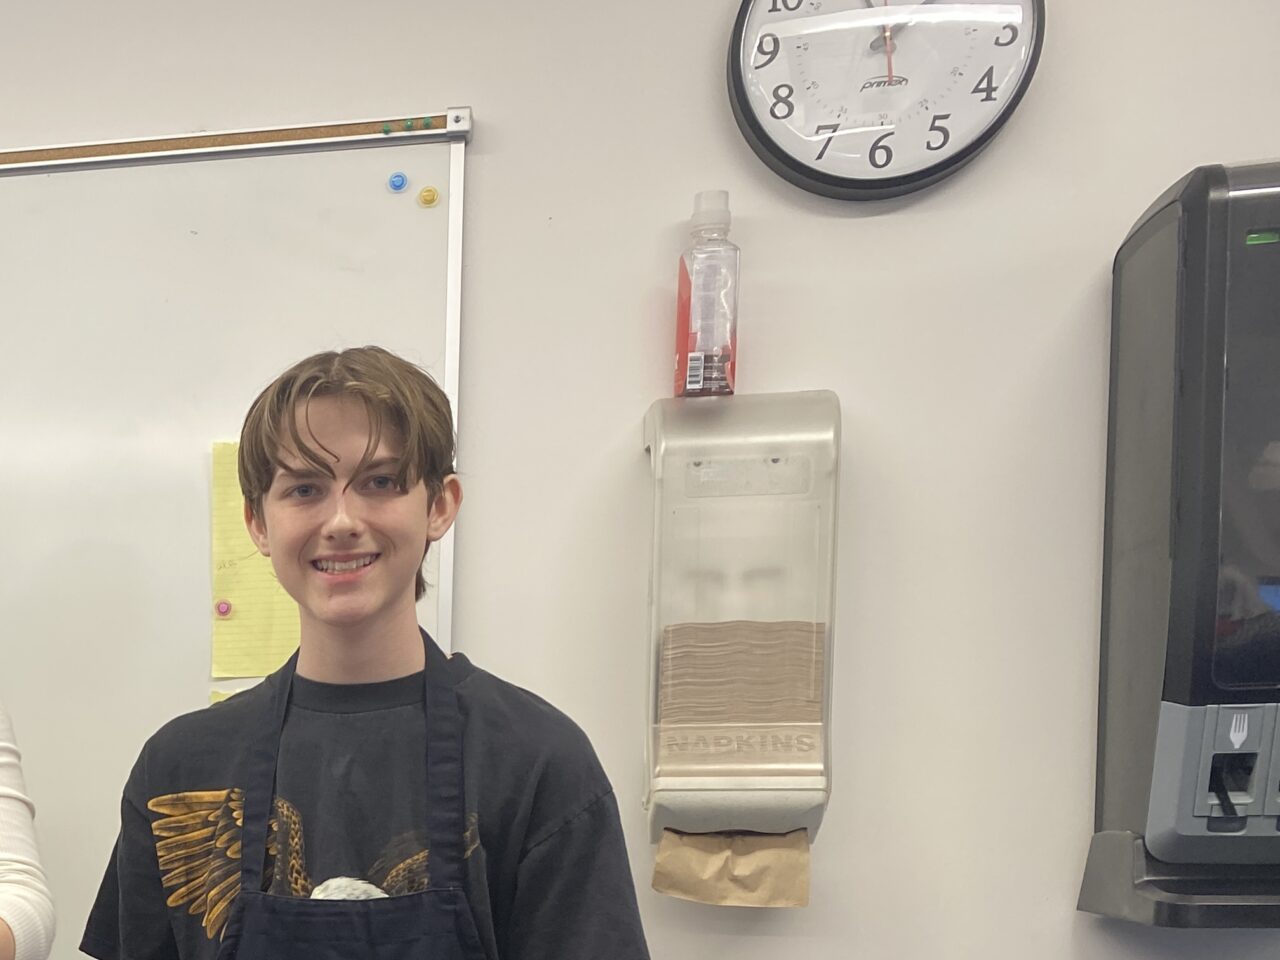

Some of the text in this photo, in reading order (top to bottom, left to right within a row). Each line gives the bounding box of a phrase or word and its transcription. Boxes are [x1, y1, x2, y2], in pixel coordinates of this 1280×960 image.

[754, 32, 780, 70] 9
[769, 83, 795, 120] 8
[970, 65, 999, 102] 4
[814, 123, 841, 160] 7
[869, 131, 895, 168] 6
[926, 113, 952, 151] 5
[665, 733, 817, 753] NAPKINS
